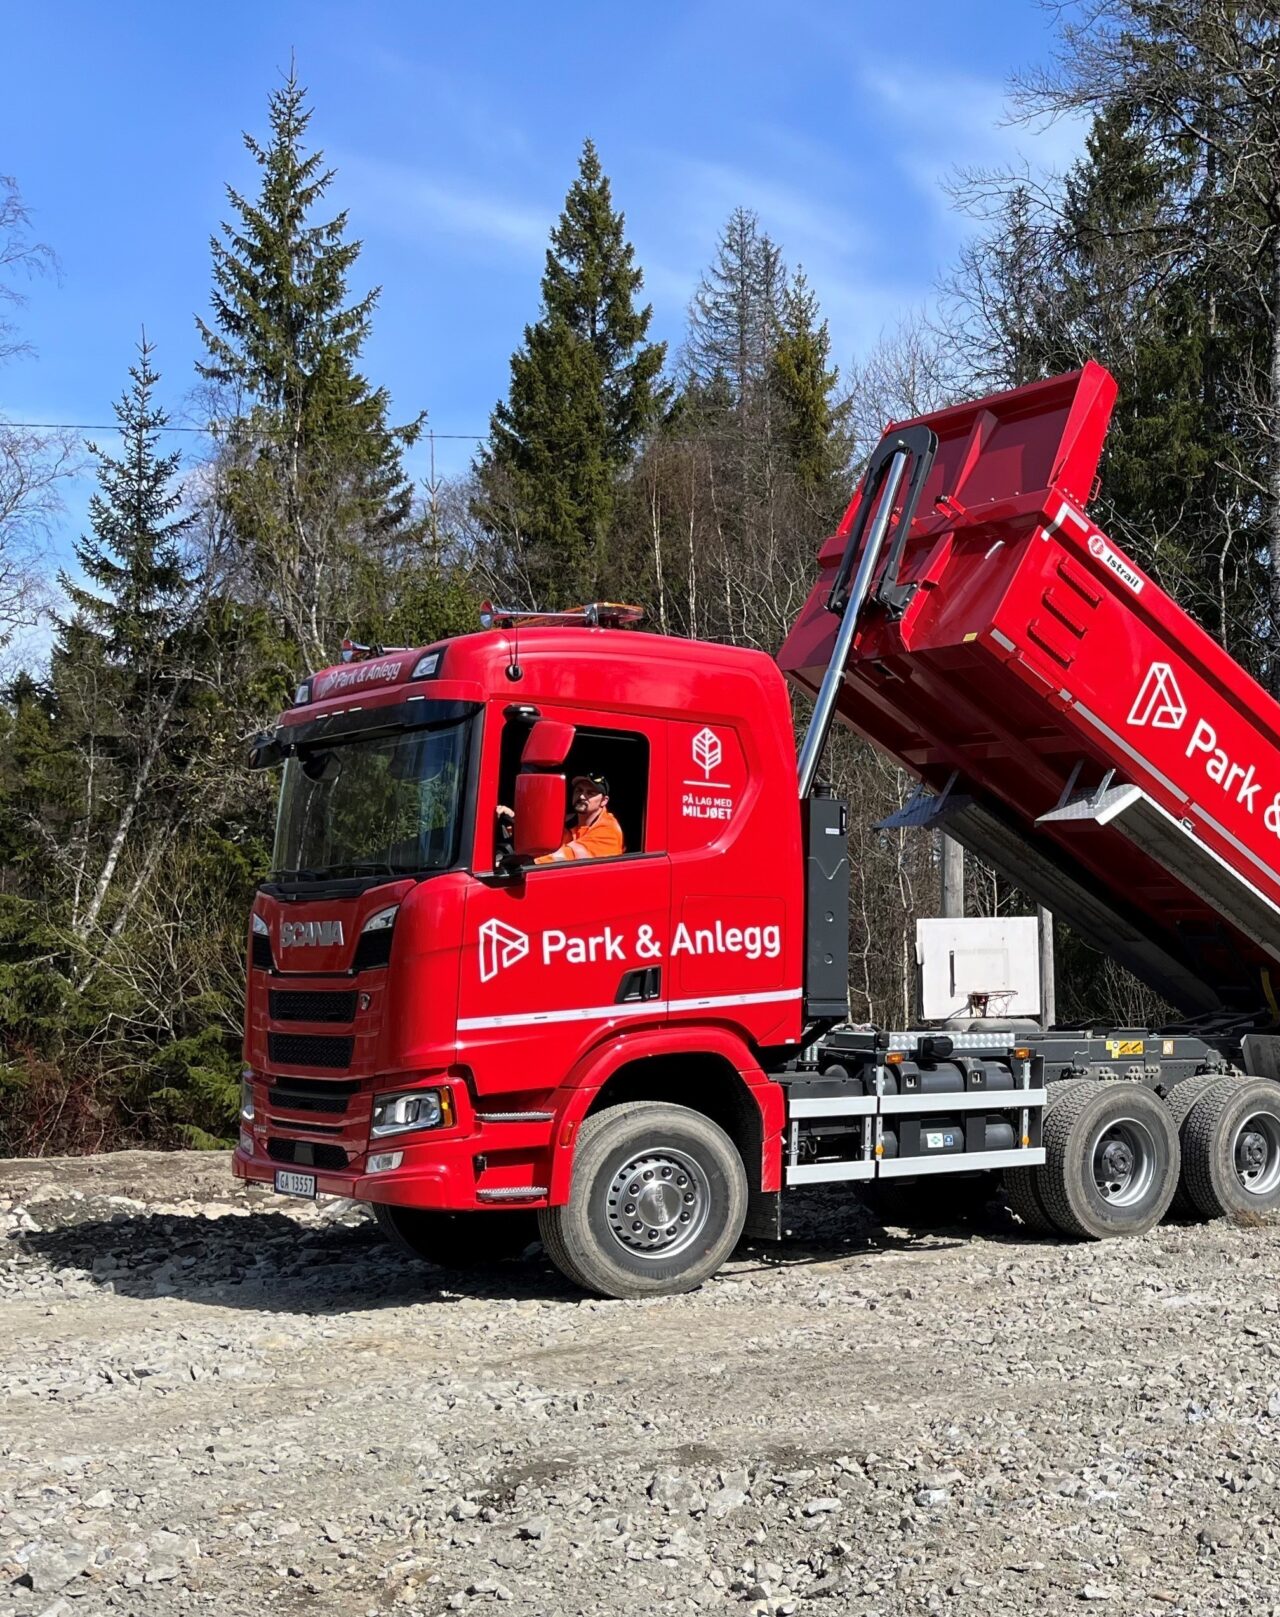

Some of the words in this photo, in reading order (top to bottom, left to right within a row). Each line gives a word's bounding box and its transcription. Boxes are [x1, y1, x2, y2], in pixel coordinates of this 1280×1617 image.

[1106, 554, 1140, 588] Istrail
[334, 669, 355, 689] Park
[356, 665, 366, 682] &
[366, 661, 402, 682] Anlegg
[1185, 717, 1262, 814] Park
[682, 792, 694, 804] PÅ
[695, 796, 712, 806] LAG
[713, 798, 732, 807] MED
[682, 805, 732, 820] MILJØET
[281, 920, 345, 948] SCANIA
[542, 926, 626, 965] Park
[635, 924, 662, 959] &
[670, 920, 781, 960] Anlegg
[280, 1173, 290, 1189] GA
[292, 1175, 313, 1193] 13557
